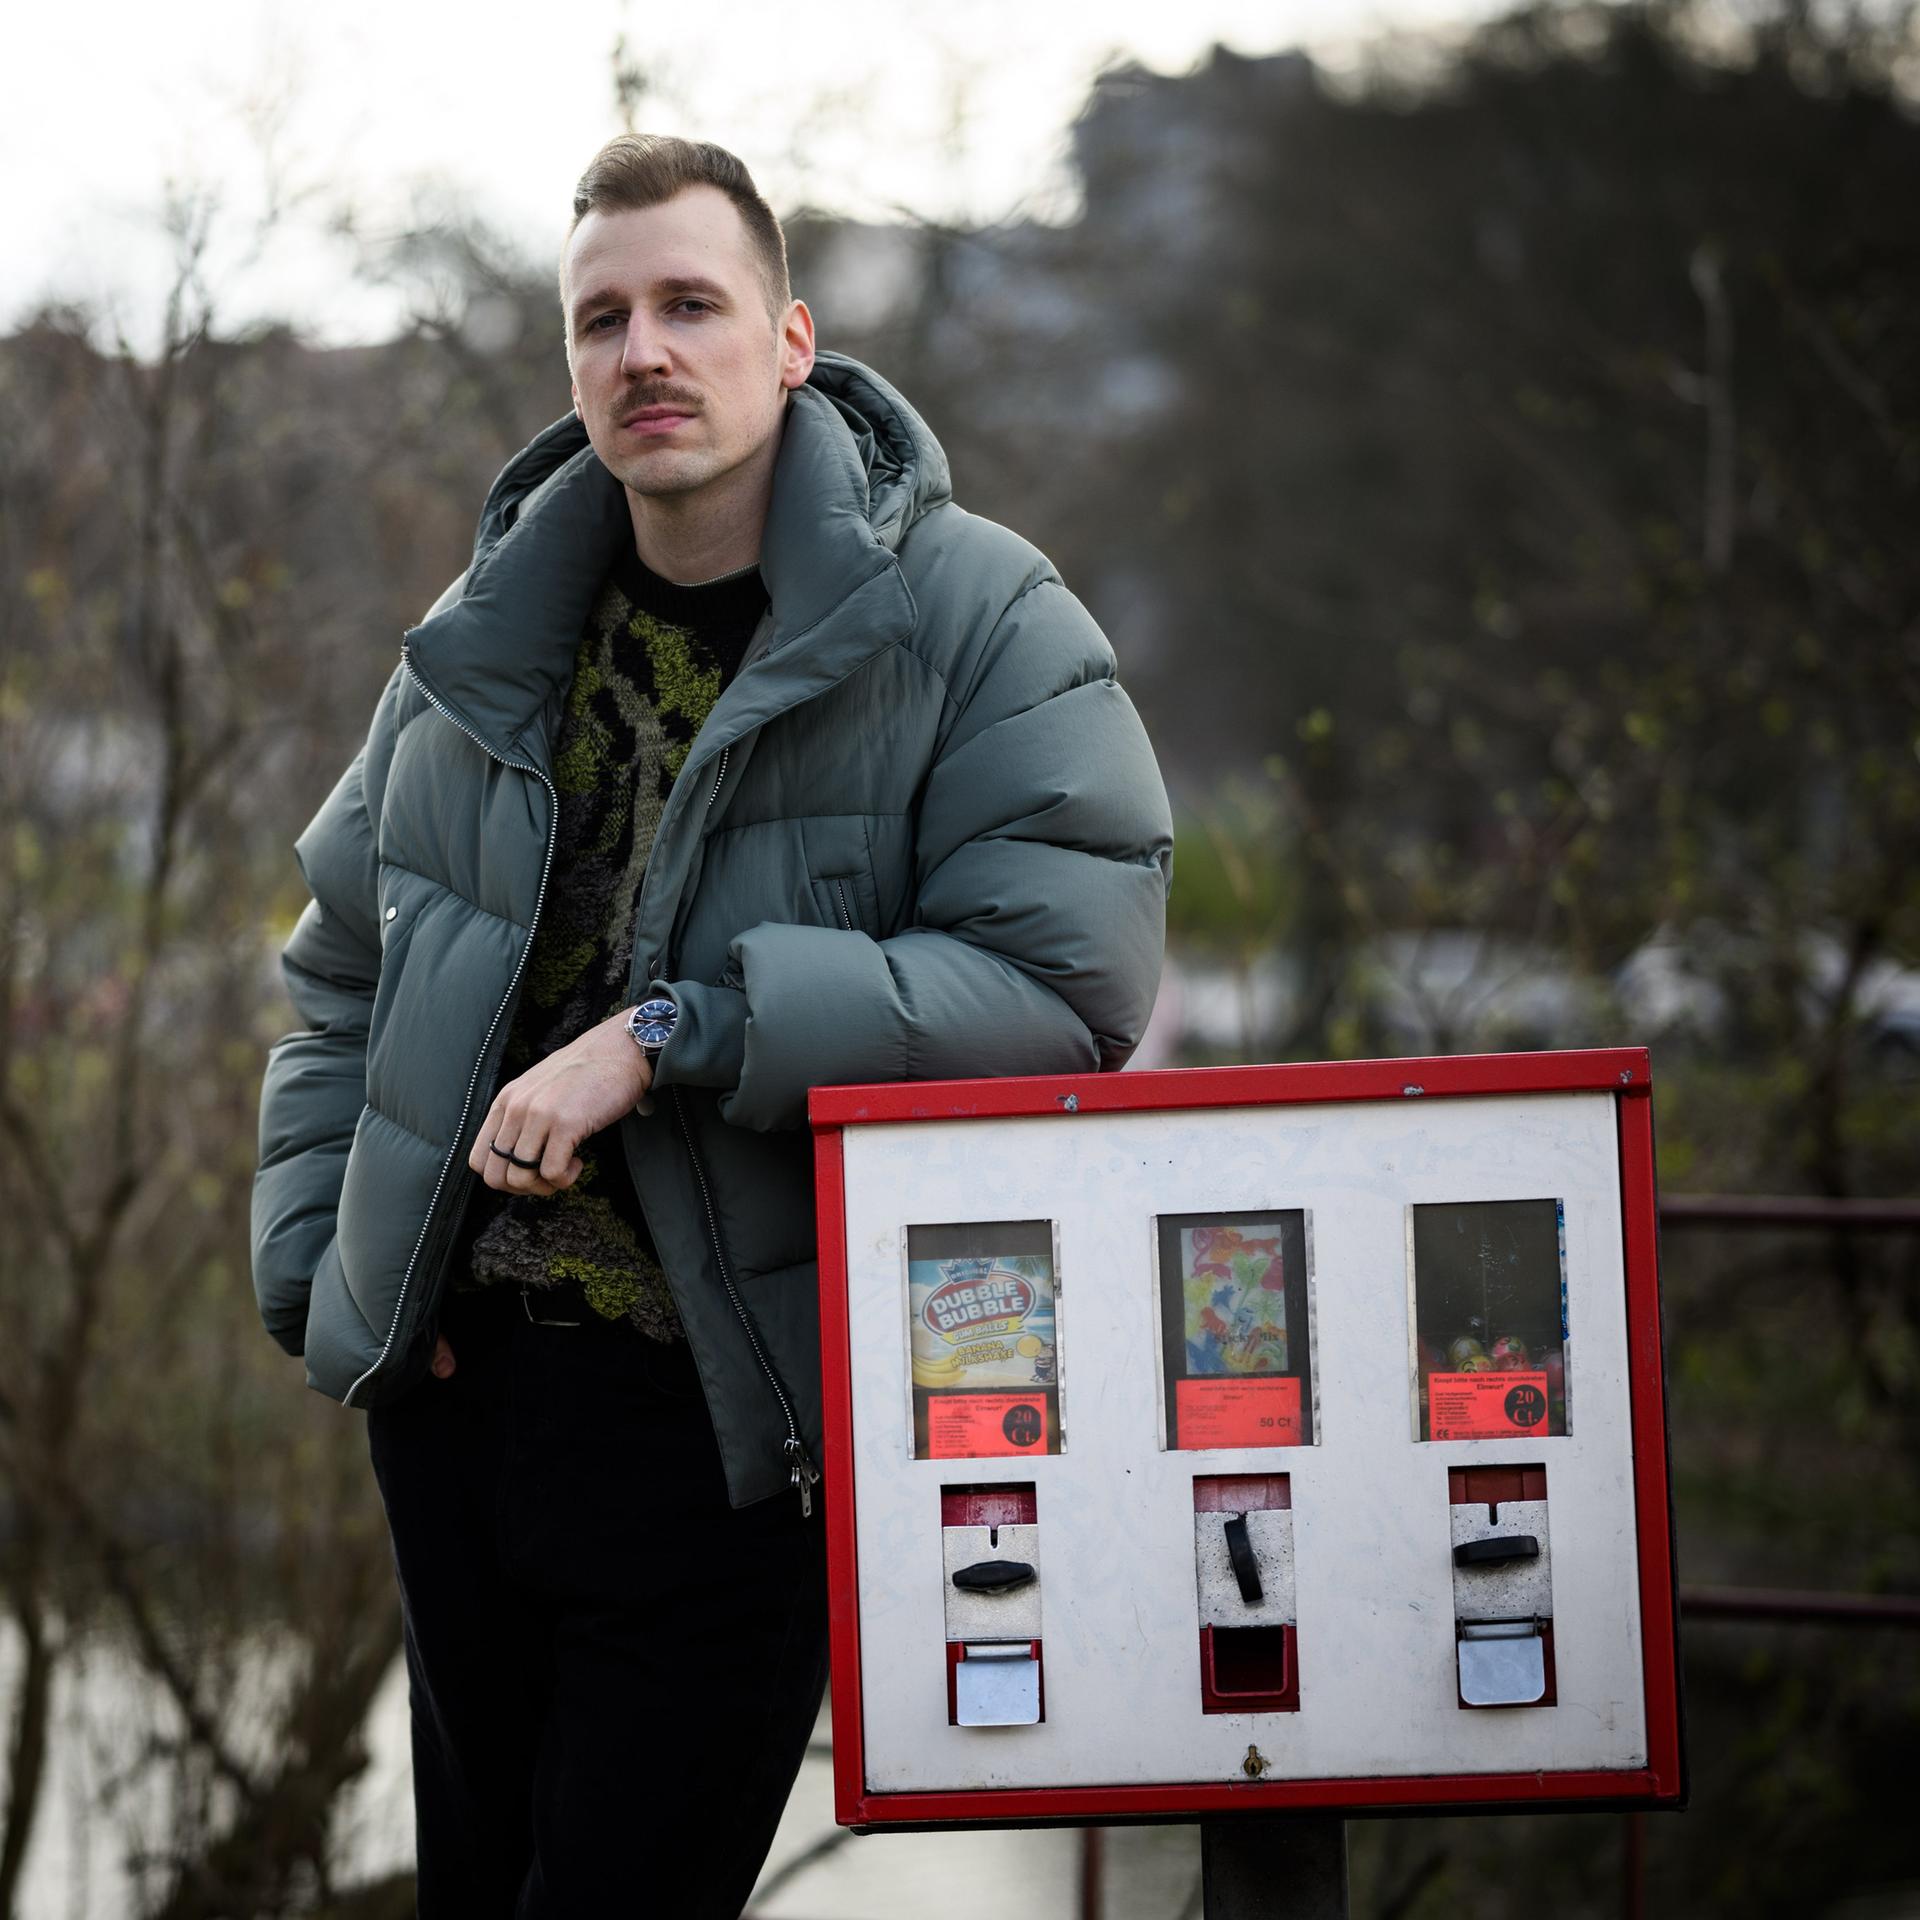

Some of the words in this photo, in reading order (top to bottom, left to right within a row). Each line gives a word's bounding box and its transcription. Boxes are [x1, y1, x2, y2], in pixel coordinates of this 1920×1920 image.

[931, 1281, 1018, 1314] DUBBLE
[937, 1296, 1025, 1330] BUBBLE
[976, 1320, 1009, 1336] BALLS
[957, 1340, 1004, 1355] BANANA
[951, 1349, 1014, 1368] MILKSHAKE
[1516, 1390, 1534, 1404] 20
[1014, 1410, 1032, 1424] 20
[1260, 1417, 1274, 1428] 50
[1278, 1416, 1292, 1428] Ct
